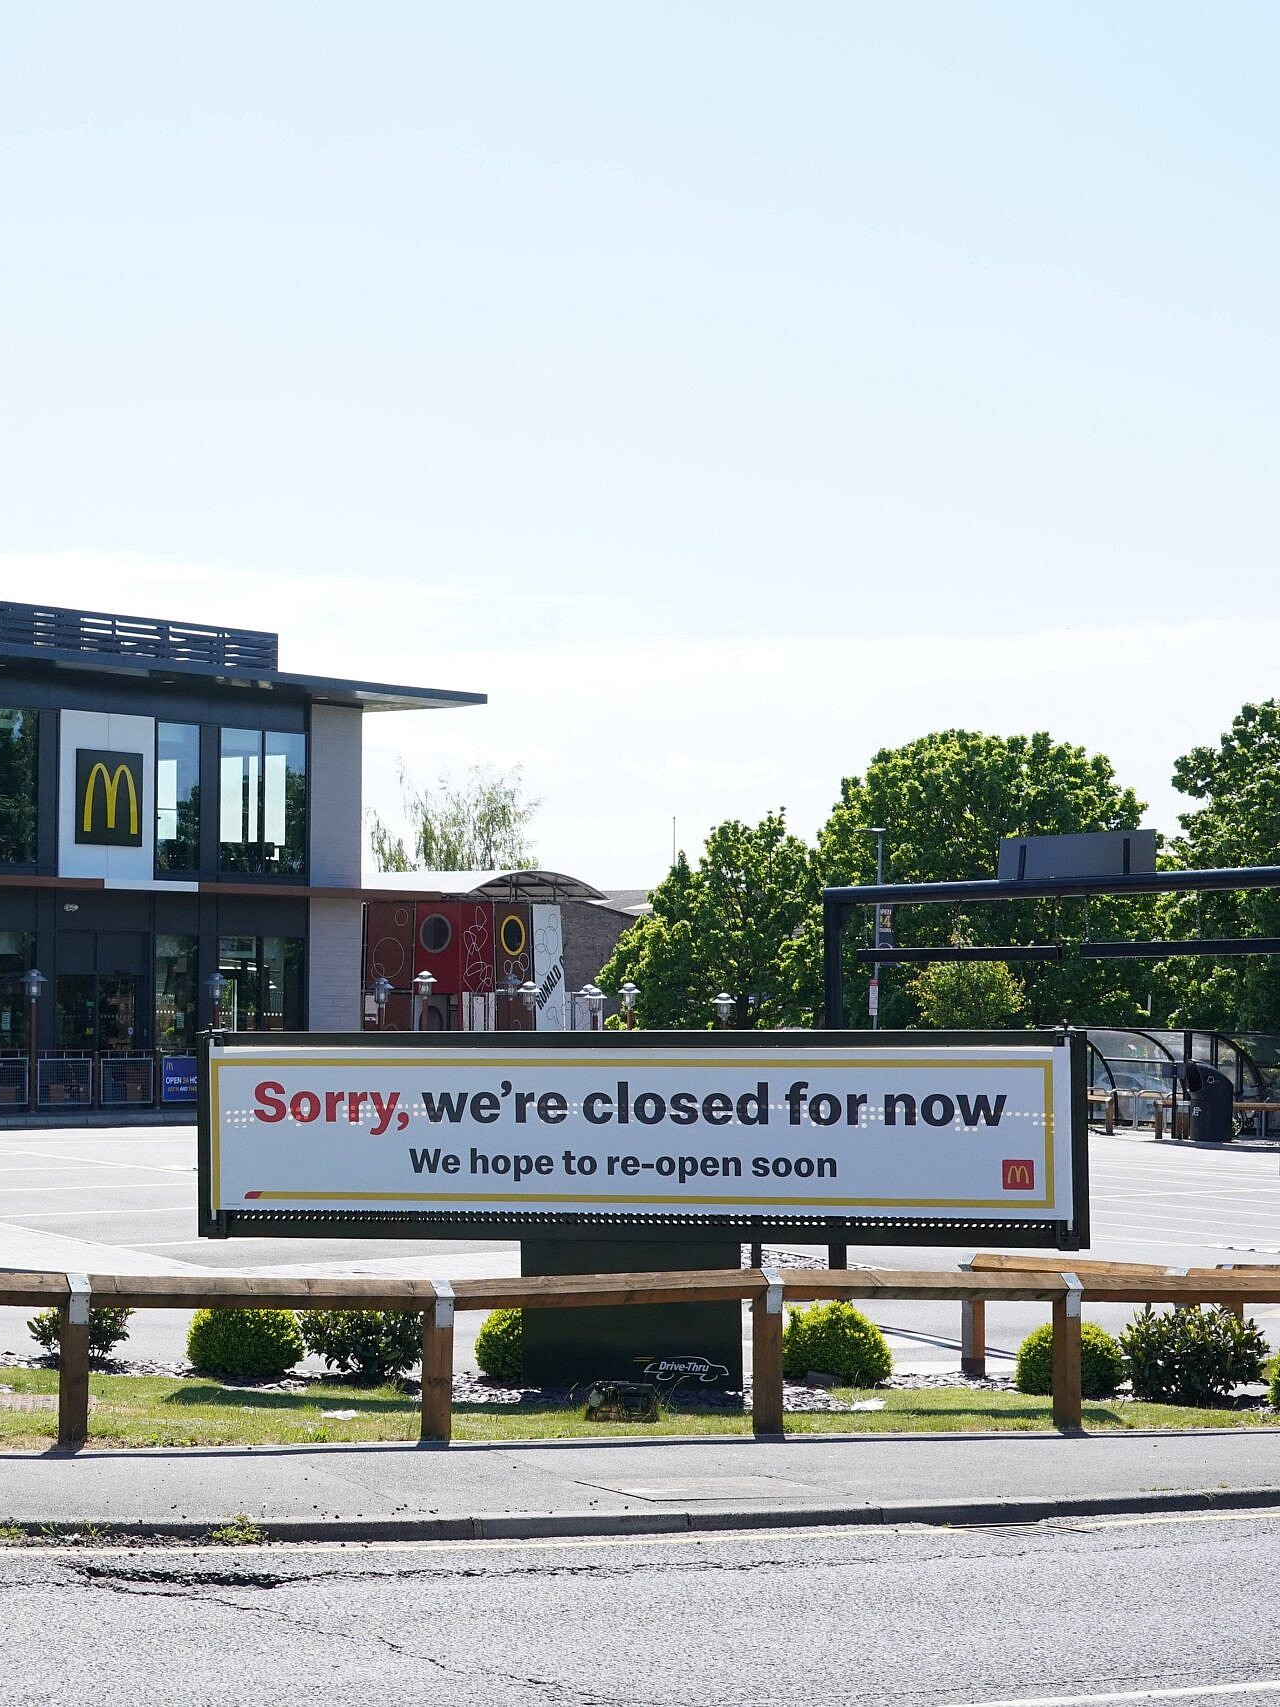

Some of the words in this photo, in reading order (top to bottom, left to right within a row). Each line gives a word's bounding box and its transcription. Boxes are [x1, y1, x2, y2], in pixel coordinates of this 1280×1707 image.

[254, 1081, 409, 1136] Sorry,
[422, 1080, 571, 1124] we're
[582, 1081, 769, 1126] closed
[785, 1082, 867, 1126] for
[884, 1094, 1007, 1127] now
[409, 1148, 460, 1174] We
[471, 1148, 553, 1182] hope
[564, 1151, 597, 1176] to
[607, 1155, 742, 1183] re-open
[751, 1156, 837, 1178] soon
[659, 1361, 710, 1372] Drive-Thru
